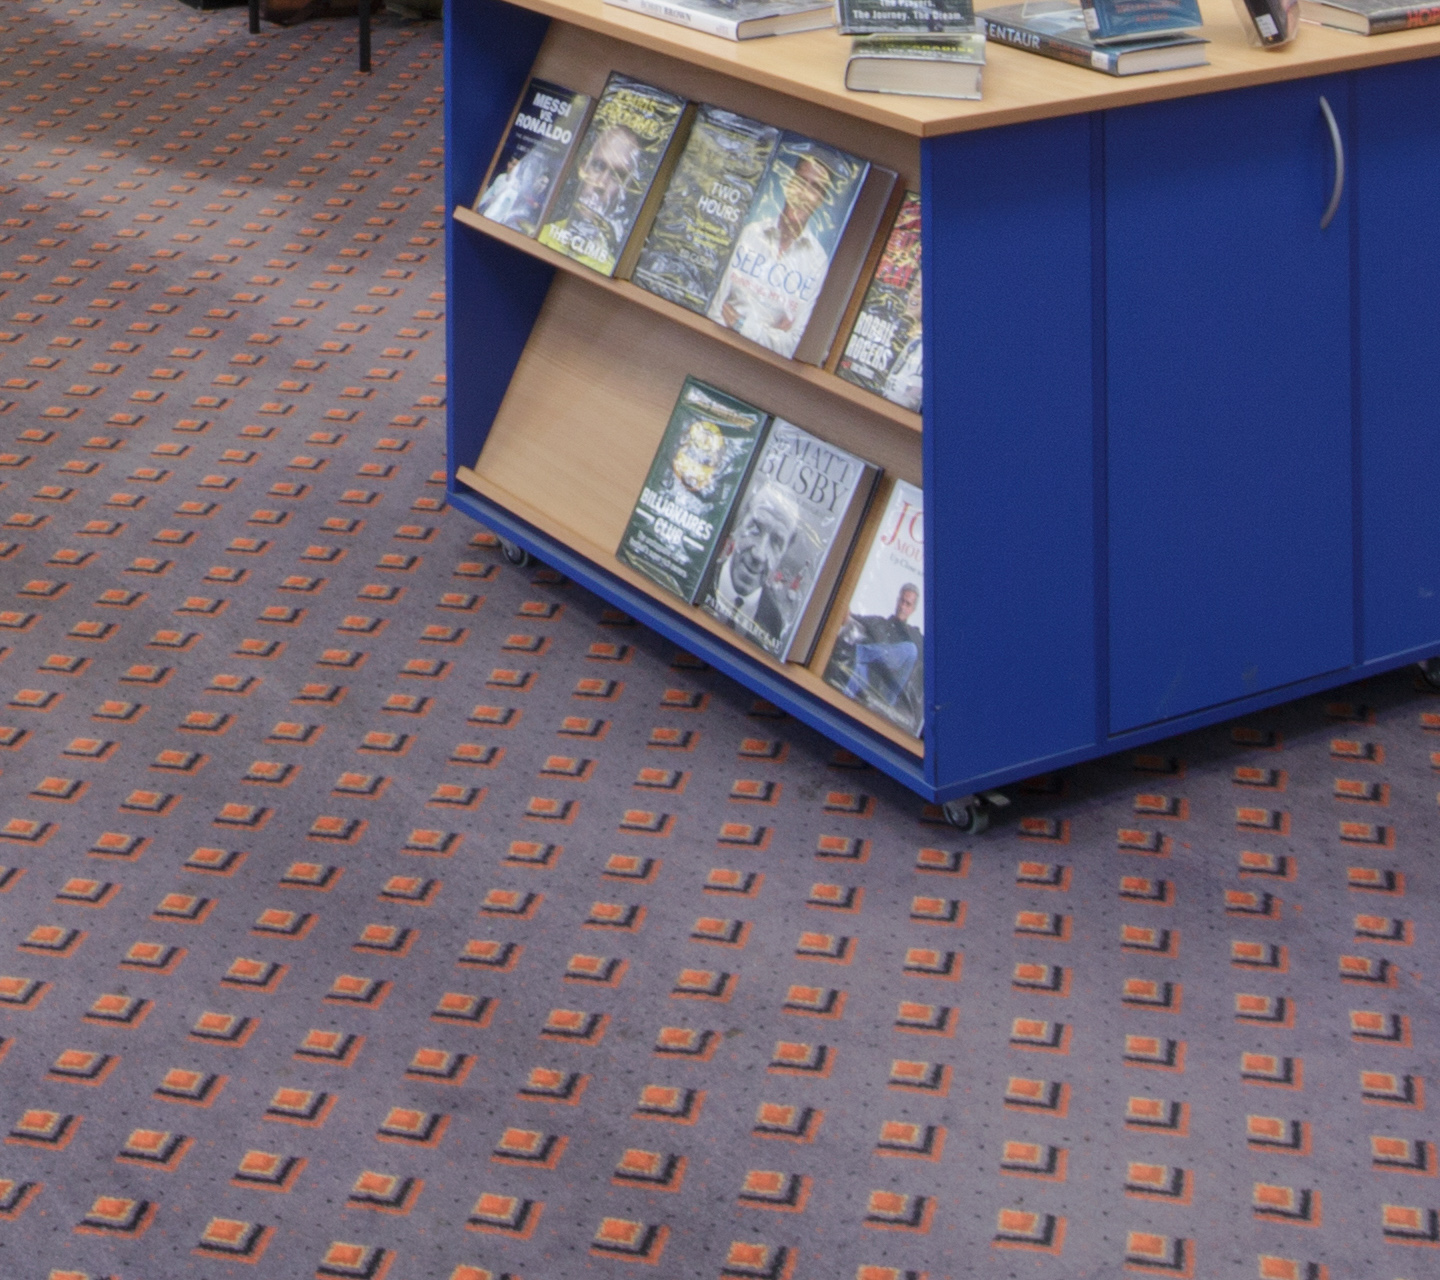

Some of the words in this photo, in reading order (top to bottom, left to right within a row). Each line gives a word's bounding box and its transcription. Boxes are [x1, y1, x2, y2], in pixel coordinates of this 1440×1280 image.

[852, 9, 870, 20] The
[532, 92, 572, 118] MESSI
[515, 113, 572, 144] RONALDO
[697, 195, 741, 223] HOURS
[710, 181, 741, 203] TWO
[549, 223, 570, 245] THE
[571, 237, 610, 263] CLIMB
[732, 245, 764, 278] SEB
[767, 262, 817, 302] COE
[854, 311, 898, 347] ROBBIE
[844, 333, 894, 371] ROGERS
[792, 435, 851, 483] MATT
[758, 455, 848, 514] BUSBY
[639, 485, 714, 541] BILLIONAIRES
[653, 518, 685, 544] CLUB
